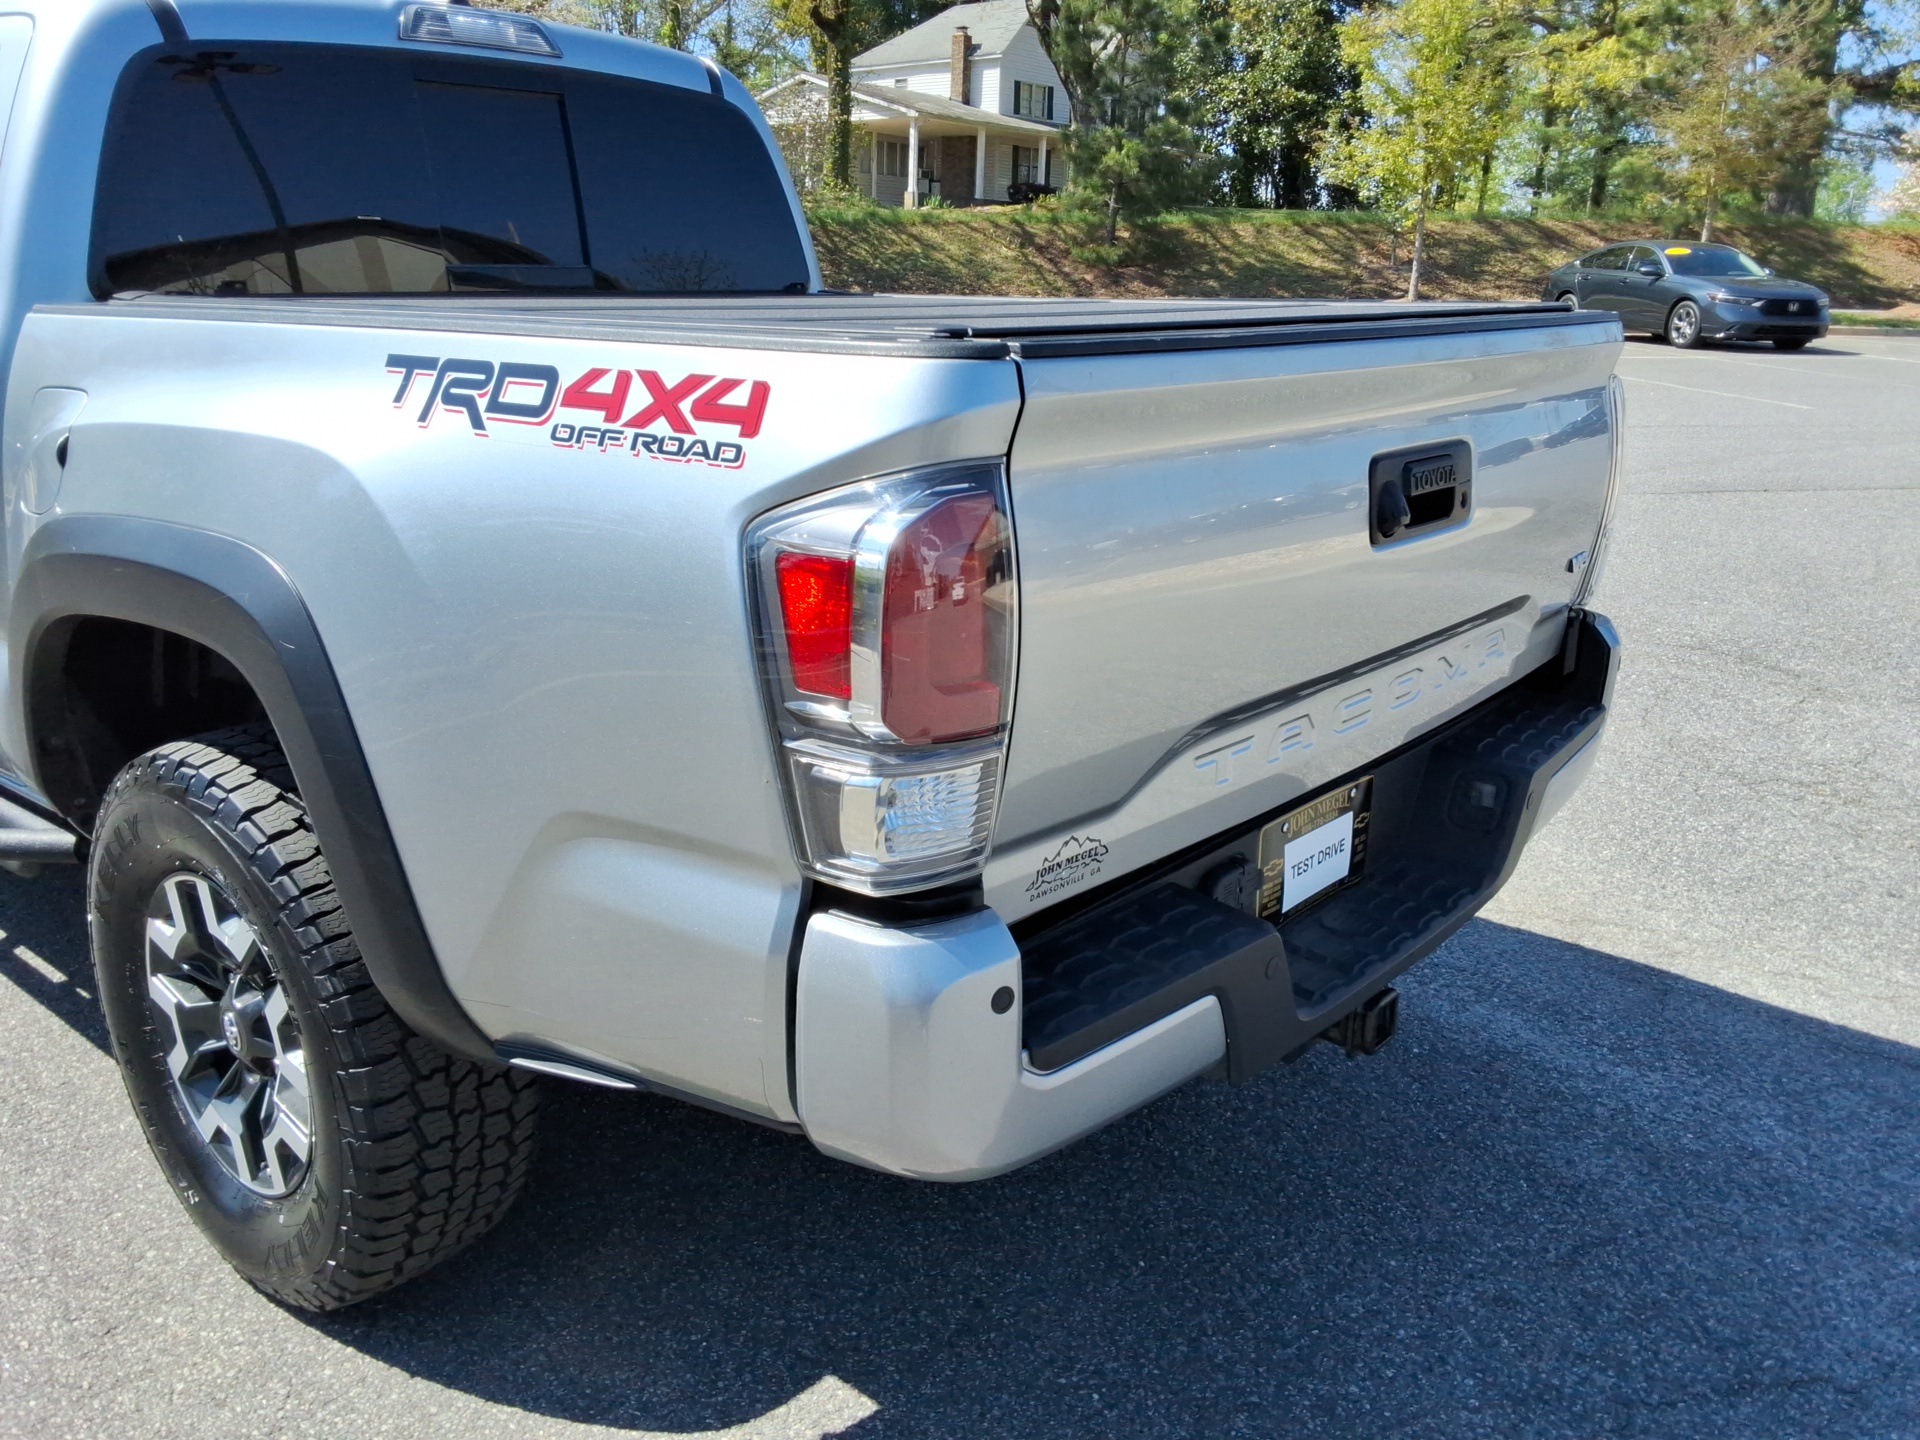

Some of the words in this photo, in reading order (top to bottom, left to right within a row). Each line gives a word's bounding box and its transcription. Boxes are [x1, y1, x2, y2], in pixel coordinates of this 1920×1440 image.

[385, 353, 562, 438] TRD
[560, 367, 771, 439] 4X4
[550, 423, 626, 452] OFF
[629, 432, 746, 470] ROAD
[1411, 464, 1457, 491] TOYOTA
[1194, 628, 1506, 786] TACOMA
[1287, 806, 1315, 839] JOHN
[1317, 789, 1351, 818] MEGEL
[1034, 861, 1063, 886] JOHN
[1065, 846, 1100, 867] MEGEL
[1291, 854, 1316, 880] TEST
[1317, 838, 1346, 865] DRIVE
[1029, 873, 1085, 902] DAWSONVILLE
[1090, 867, 1101, 876] GA
